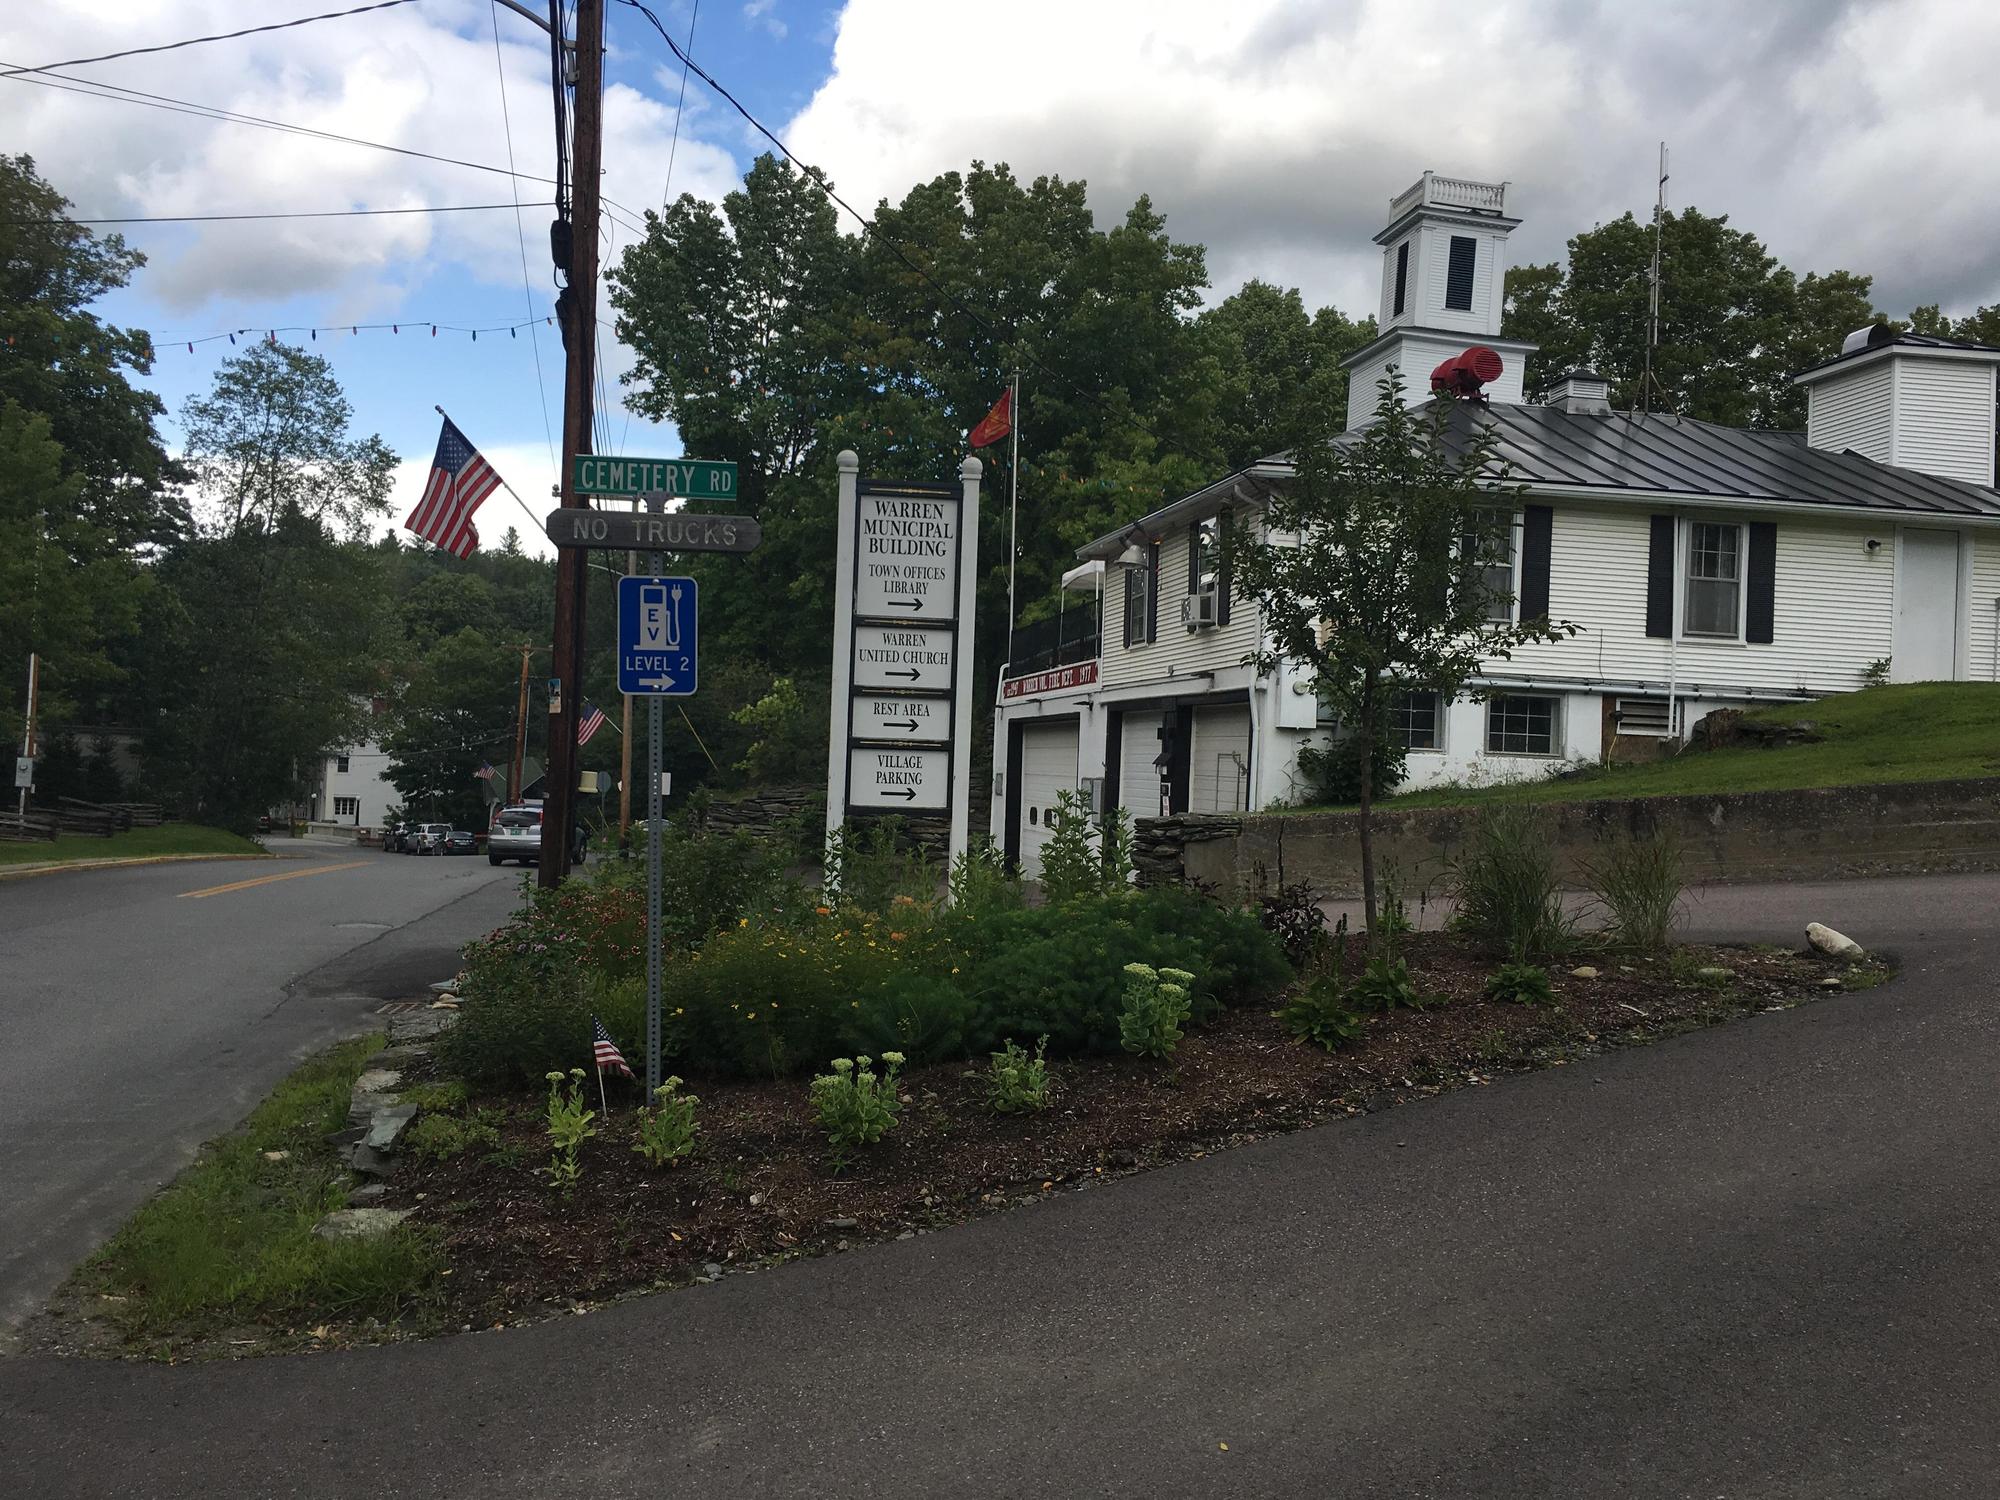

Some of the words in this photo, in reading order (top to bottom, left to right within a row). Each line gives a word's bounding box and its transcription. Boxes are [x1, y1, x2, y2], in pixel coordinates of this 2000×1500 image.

[581, 460, 696, 493] CEMETERY
[710, 470, 731, 492] RD
[875, 501, 944, 519] WARREN
[573, 518, 609, 541] NO
[632, 519, 737, 546] TRUCKS
[864, 519, 953, 539] MUNICIPAL
[869, 538, 947, 557] BUILDING
[868, 564, 900, 578] TOWN
[903, 565, 946, 580] OFFICES
[884, 580, 929, 595] LIBRARY
[882, 632, 927, 647] WARREN
[626, 656, 671, 671] LEVEL
[680, 656, 689, 671] 2
[859, 649, 900, 663] UNITED
[902, 651, 948, 665] CHURCH
[1049, 672, 1060, 688] FIRE
[873, 702, 899, 716] REST
[902, 704, 930, 717] AREA
[878, 755, 923, 769] VILLAGE
[876, 771, 923, 785] PARKING
